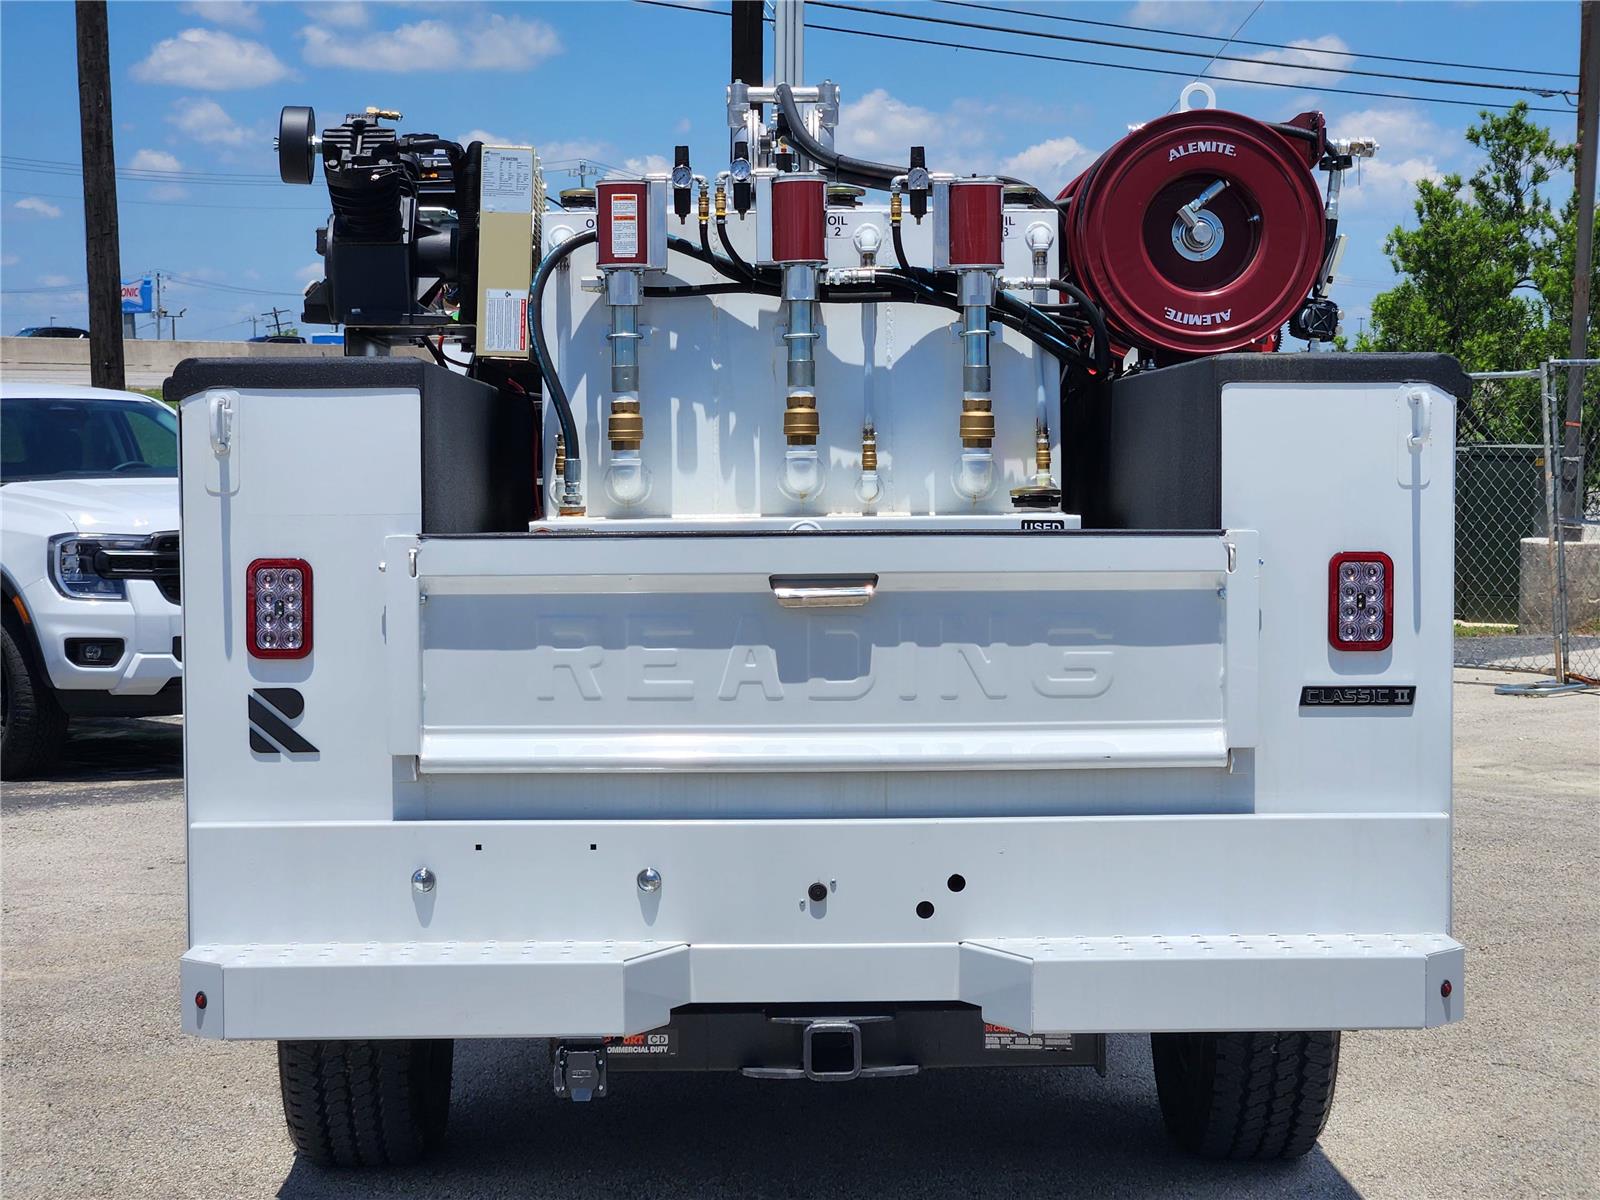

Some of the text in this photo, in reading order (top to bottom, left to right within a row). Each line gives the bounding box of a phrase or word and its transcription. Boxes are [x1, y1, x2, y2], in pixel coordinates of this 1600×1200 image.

[827, 216, 848, 226] OIL
[1004, 216, 1016, 226] IL
[834, 227, 841, 236] 2
[120, 288, 139, 297] ONIC
[536, 613, 1115, 701] READING
[1305, 688, 1410, 704] CLASSIC II
[650, 1035, 667, 1044] CD
[606, 1045, 669, 1054] OMMERCIAL DUTY
